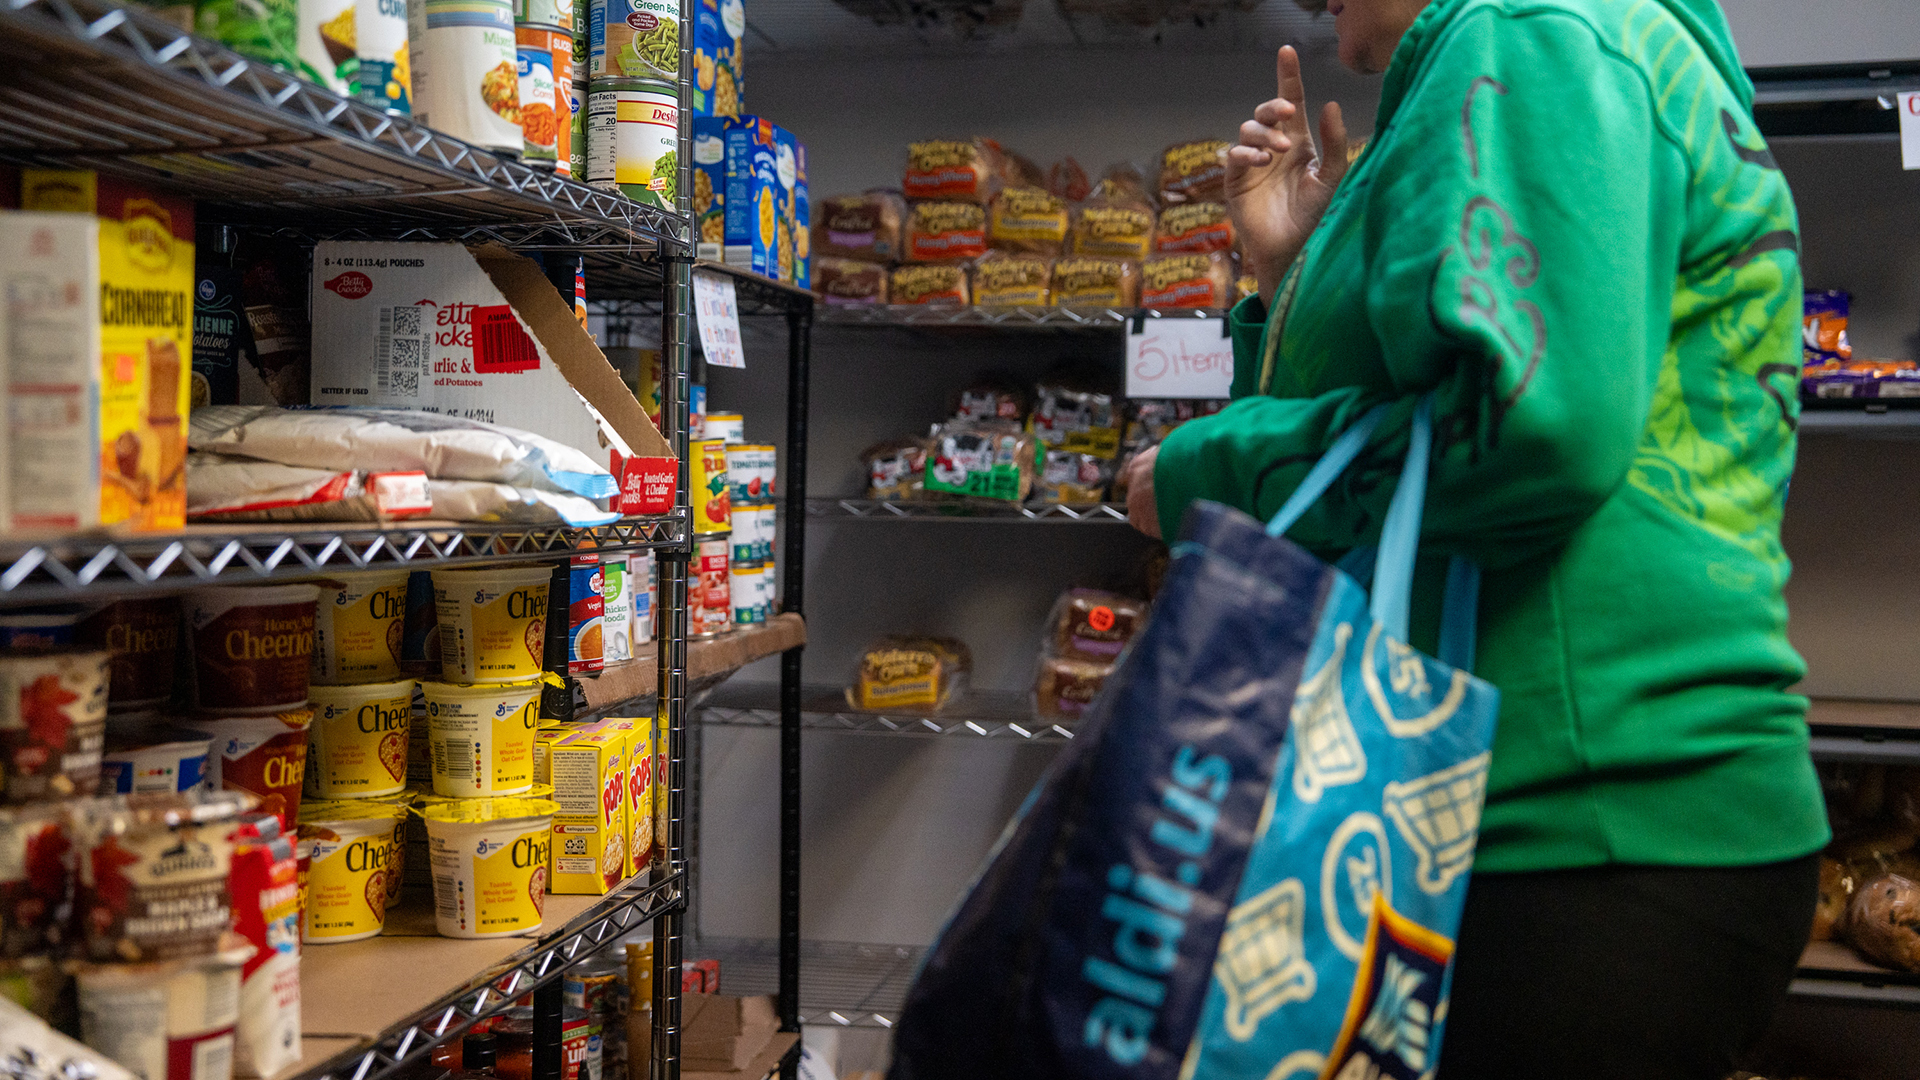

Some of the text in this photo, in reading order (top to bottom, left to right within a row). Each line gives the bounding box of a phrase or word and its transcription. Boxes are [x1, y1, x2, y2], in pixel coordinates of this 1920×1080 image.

[634, 0, 680, 16] Green Bea
[605, 117, 616, 125] 20
[324, 258, 330, 266] 8
[336, 258, 342, 266] 4
[344, 258, 354, 266] OZ
[356, 258, 387, 268] (113.4g)
[390, 258, 425, 268] POUCHES
[337, 284, 367, 294] Crocker
[340, 276, 365, 287] Betty
[100, 283, 187, 333] CORNBREAD
[194, 316, 234, 336] LIENNE
[460, 358, 471, 374] &
[1134, 336, 1169, 381] 5
[446, 378, 483, 387] Potatoes
[660, 472, 674, 483] Garlic
[650, 484, 669, 495] Cheddar
[628, 754, 652, 815] POPS
[602, 770, 624, 829] POPS
[1082, 746, 1233, 1065] aldi.us
